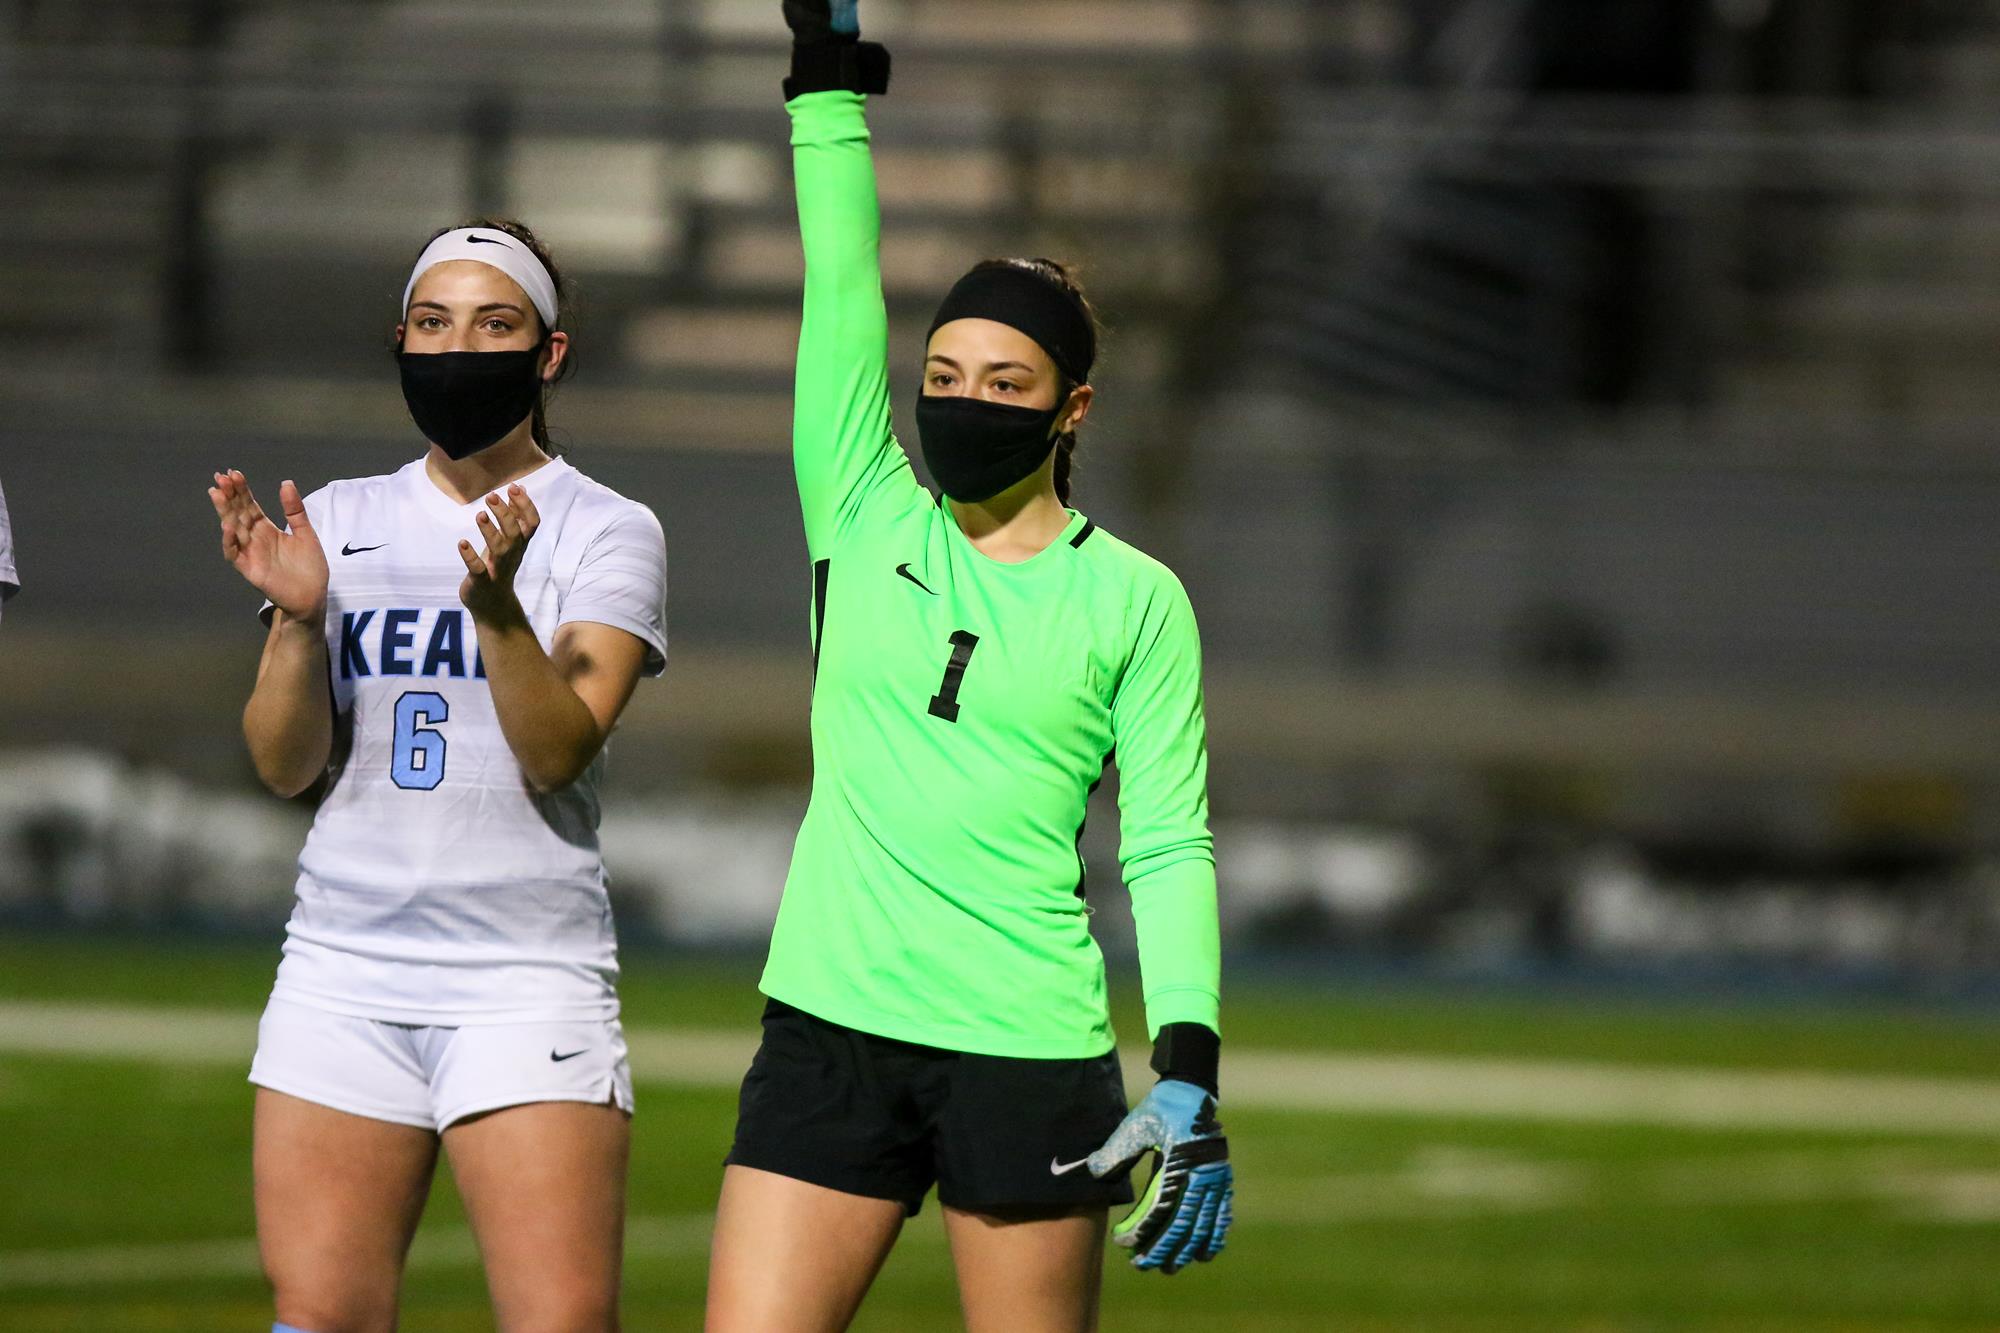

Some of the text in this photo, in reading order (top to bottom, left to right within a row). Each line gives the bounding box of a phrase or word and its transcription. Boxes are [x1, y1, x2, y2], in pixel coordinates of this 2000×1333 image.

[340, 608, 489, 680] KEA
[927, 629, 980, 723] 1
[390, 690, 449, 791] 6
